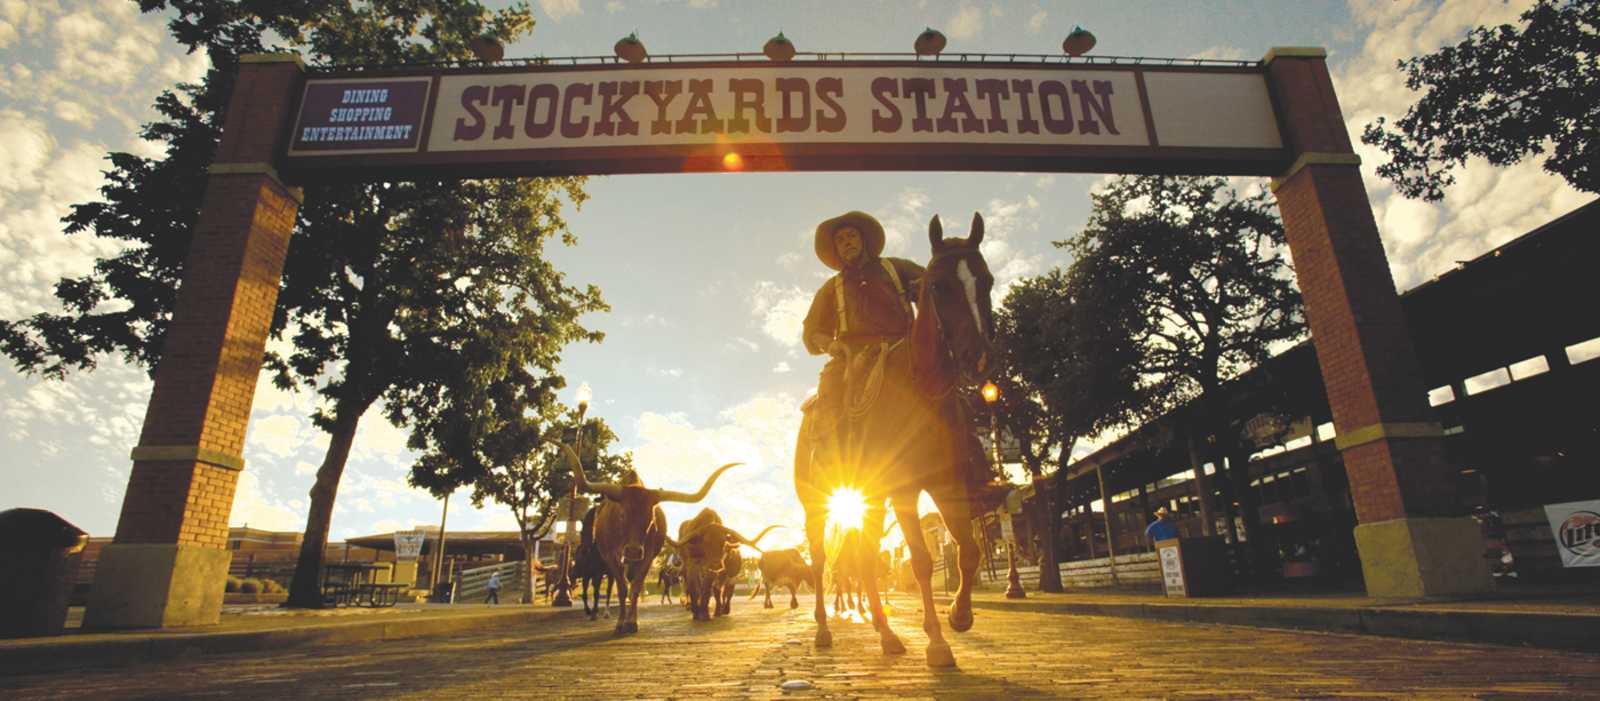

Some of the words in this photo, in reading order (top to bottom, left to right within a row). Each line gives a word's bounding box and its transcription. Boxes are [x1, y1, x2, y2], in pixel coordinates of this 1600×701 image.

[341, 89, 389, 104] DINING
[329, 106, 392, 122] SHOPPING
[453, 77, 846, 142] STOCKYARDS
[870, 77, 1121, 136] STATION
[301, 125, 413, 142] ENTERTAINMENT
